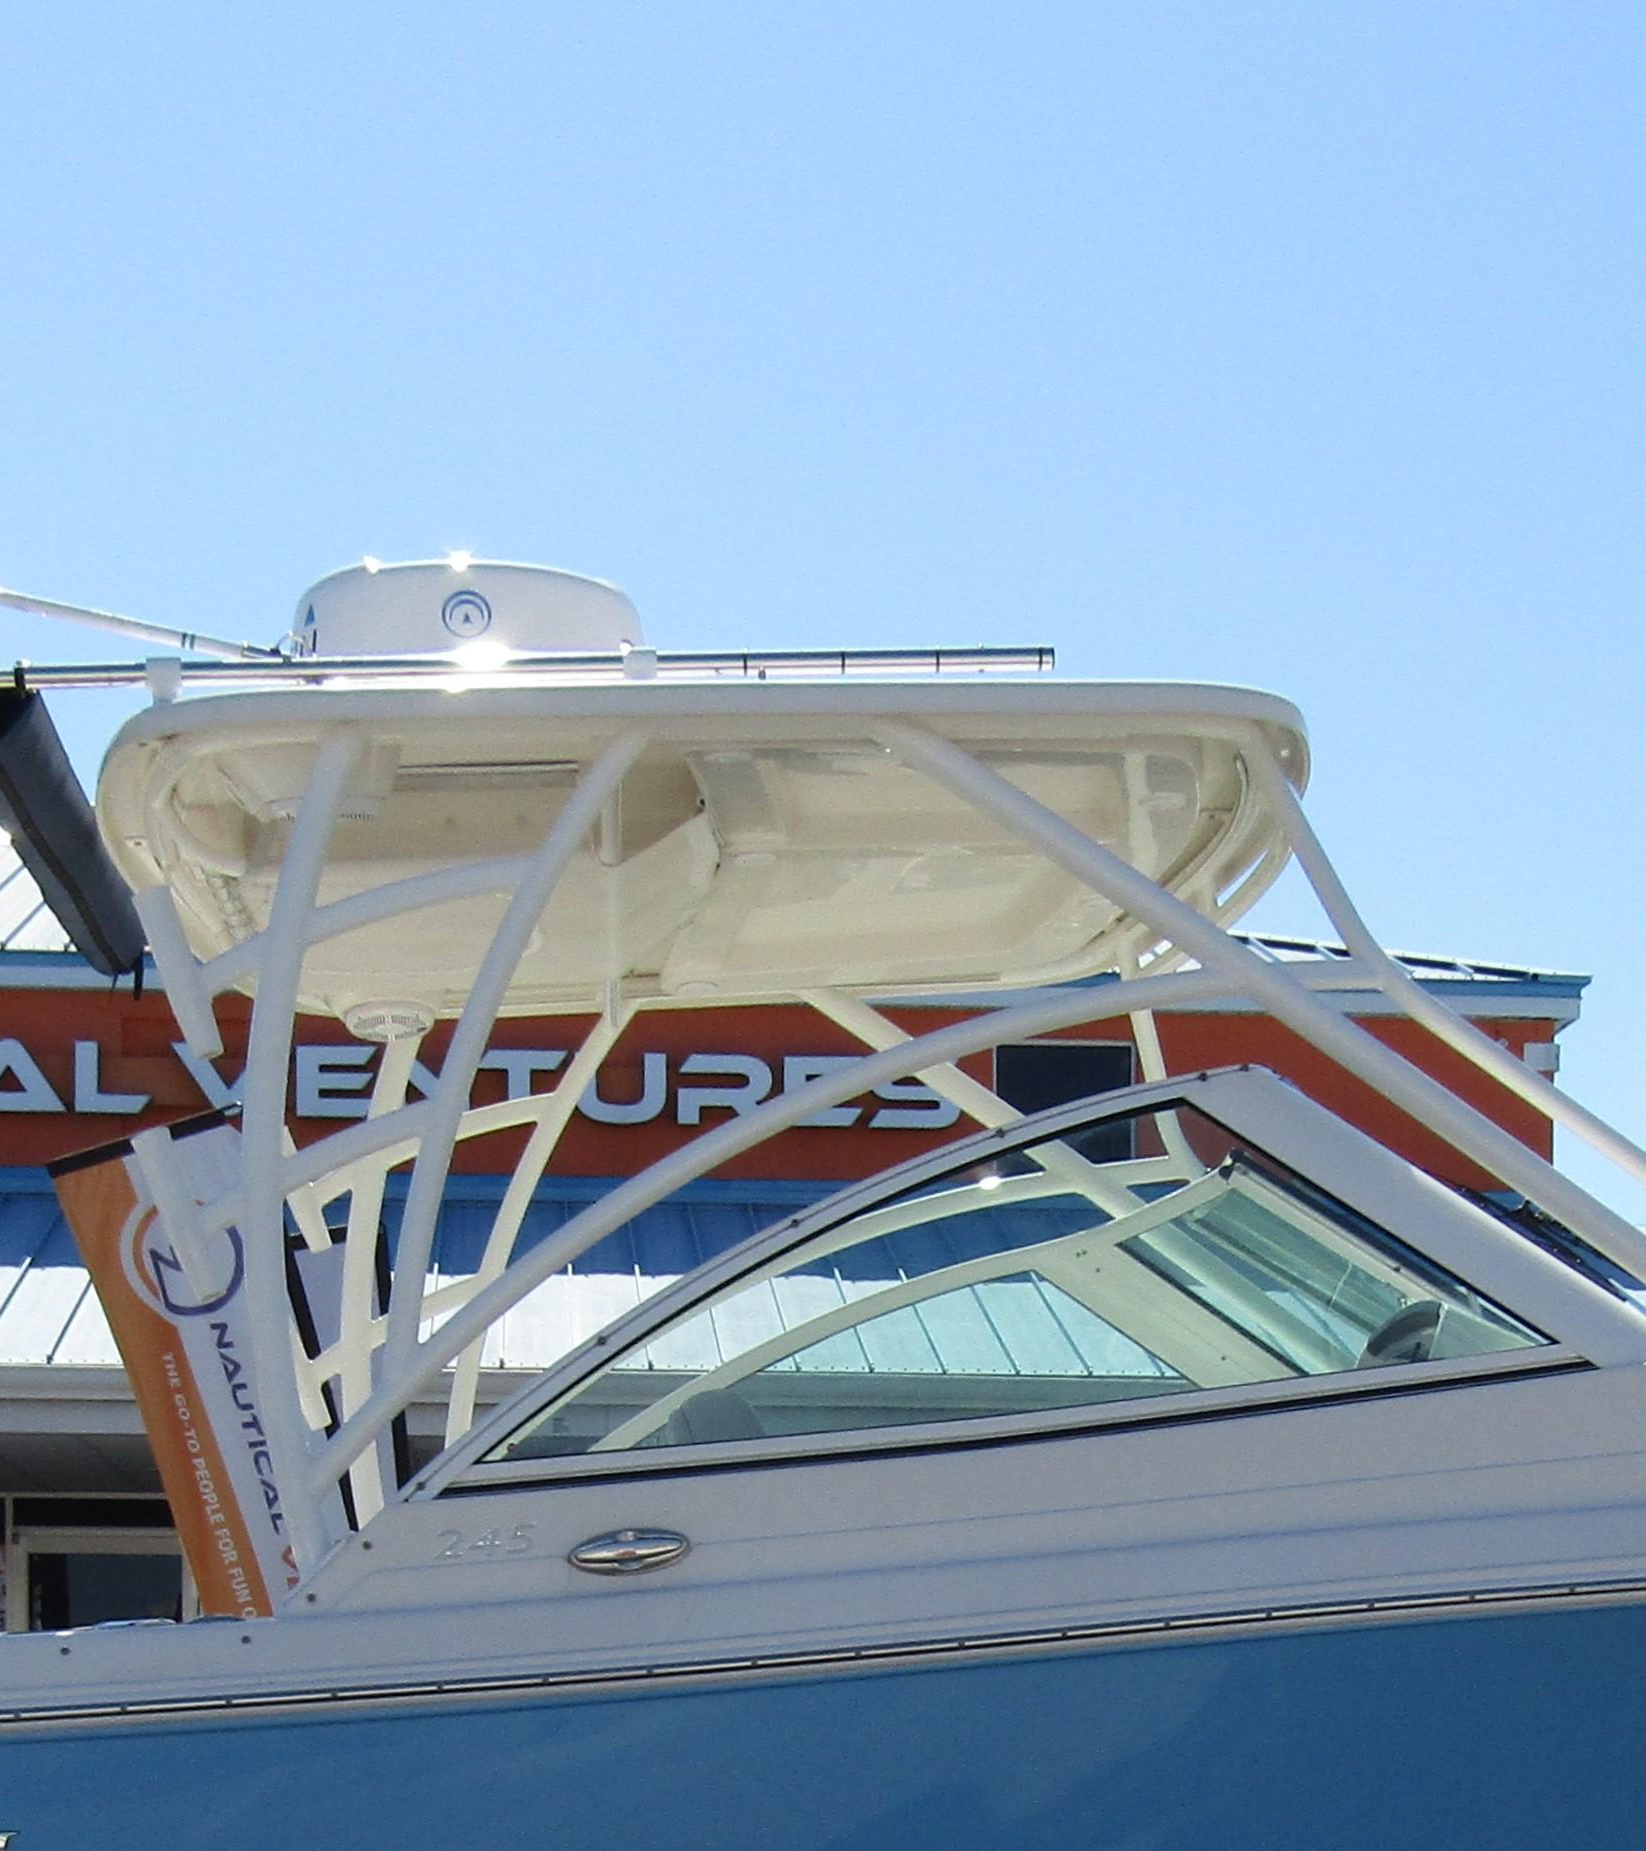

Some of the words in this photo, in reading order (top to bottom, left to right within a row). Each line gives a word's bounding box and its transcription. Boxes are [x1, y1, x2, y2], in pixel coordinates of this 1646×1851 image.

[170, 1040, 962, 1130] VETURES
[161, 1351, 182, 1388] THE
[173, 1393, 202, 1452] GO-TO
[192, 1457, 225, 1525] PEOPLE
[214, 1526, 239, 1566] FOR
[227, 1566, 253, 1604] FUN
[210, 1321, 285, 1536] NAUTICAL
